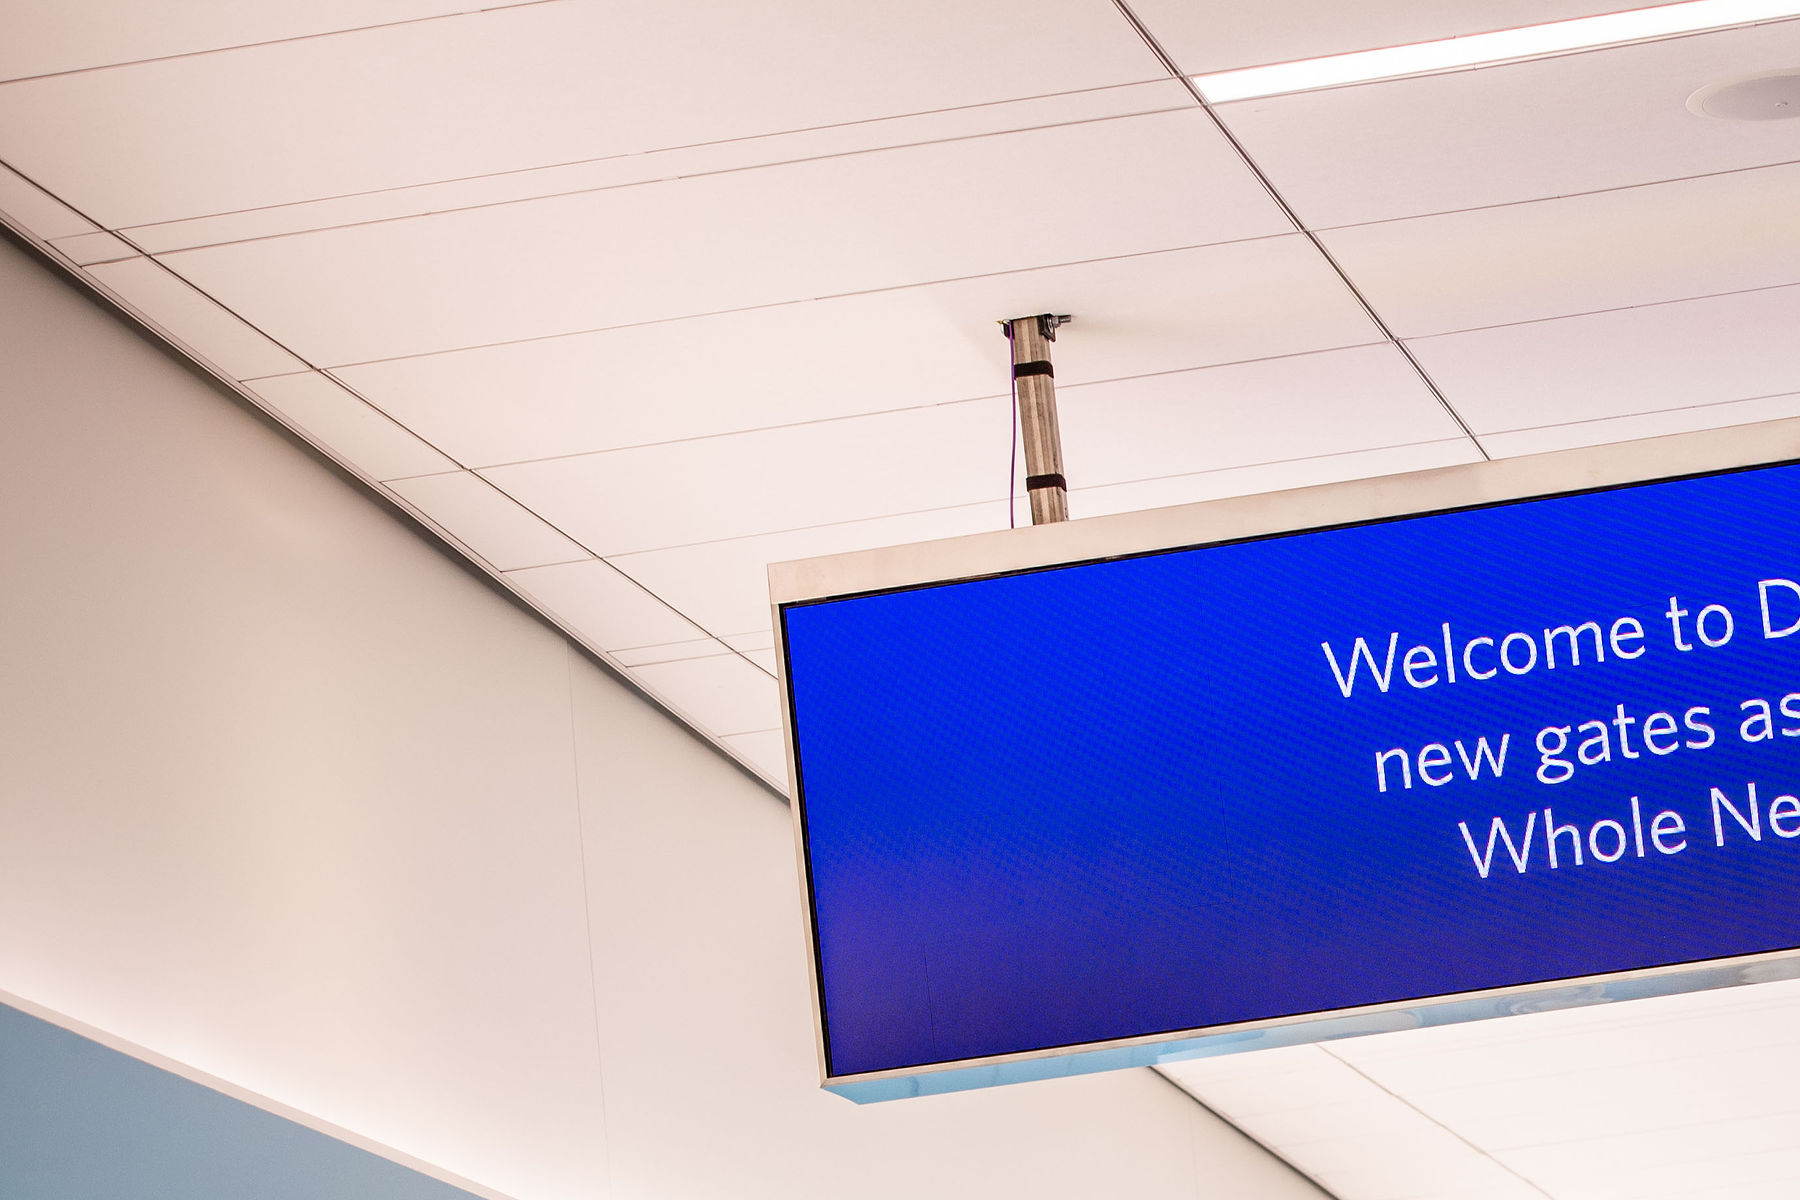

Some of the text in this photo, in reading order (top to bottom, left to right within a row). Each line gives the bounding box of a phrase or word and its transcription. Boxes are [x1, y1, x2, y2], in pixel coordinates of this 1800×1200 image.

[1320, 616, 1646, 698] Welcome
[1665, 596, 1735, 652] to
[1375, 733, 1511, 793] new
[1535, 703, 1716, 785] gates
[1457, 795, 1688, 879] Whole
